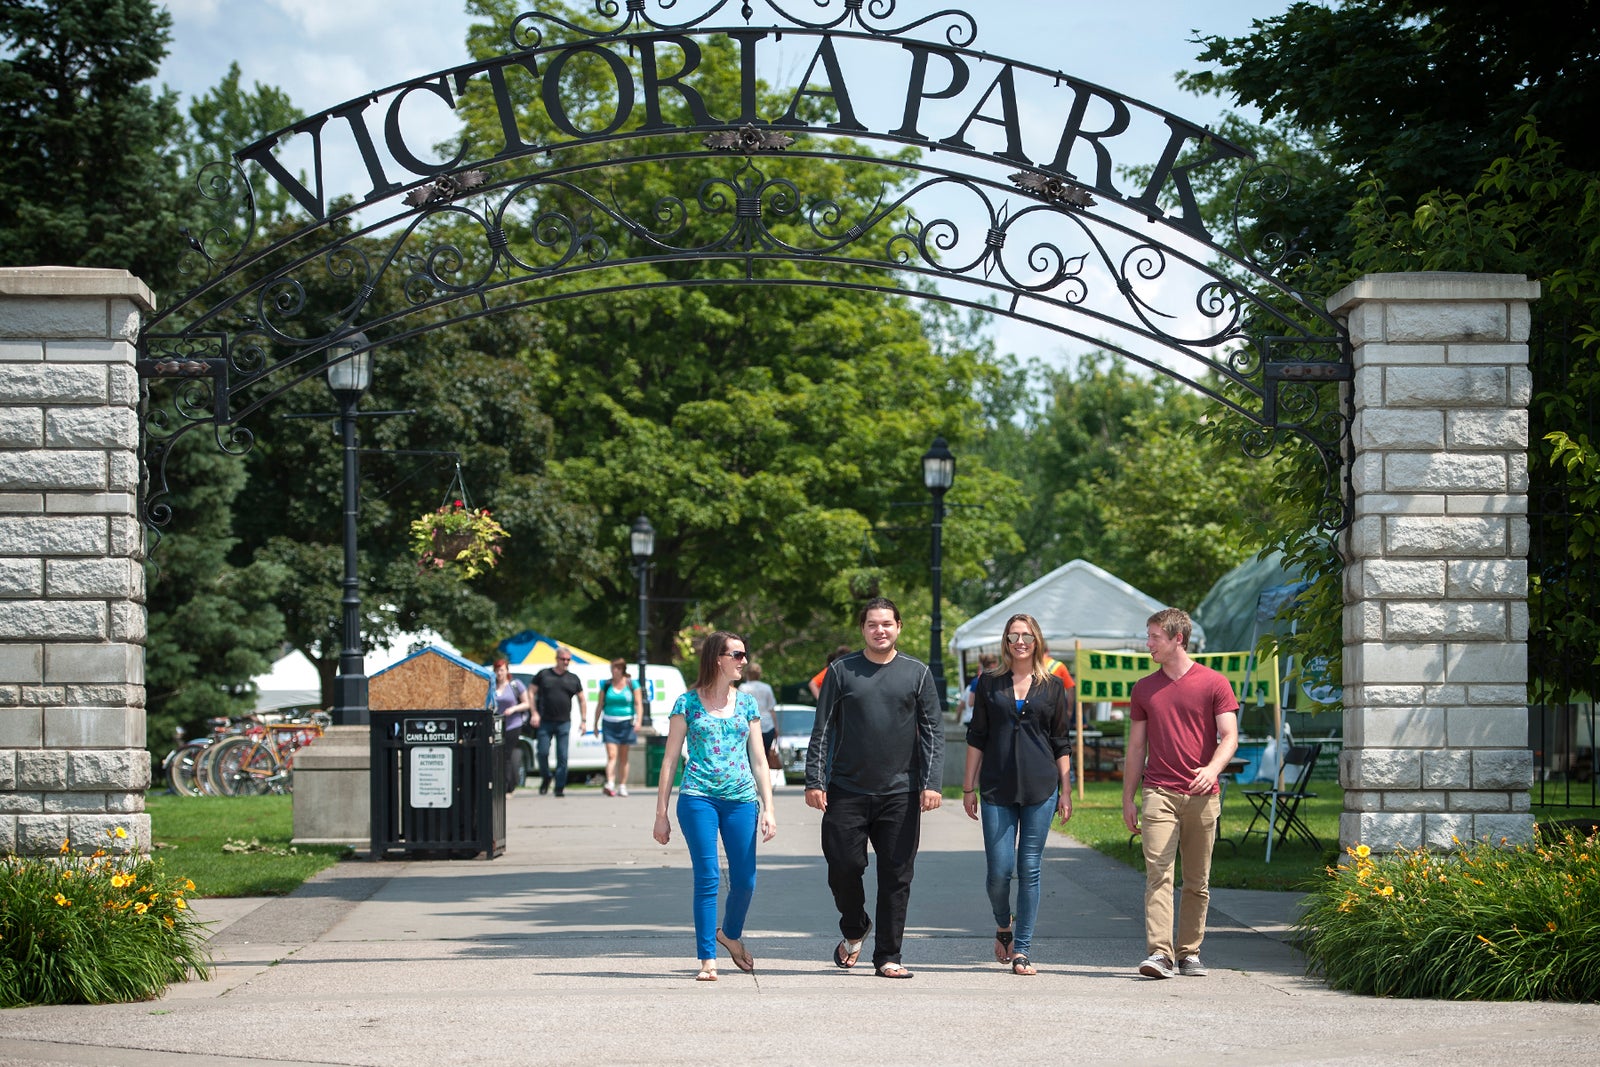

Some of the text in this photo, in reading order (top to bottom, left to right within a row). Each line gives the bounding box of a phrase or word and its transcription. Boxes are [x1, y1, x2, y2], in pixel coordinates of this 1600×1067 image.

[235, 31, 1246, 242] VICTORIA PARK
[406, 733, 422, 741] CANS
[424, 733, 428, 741] &
